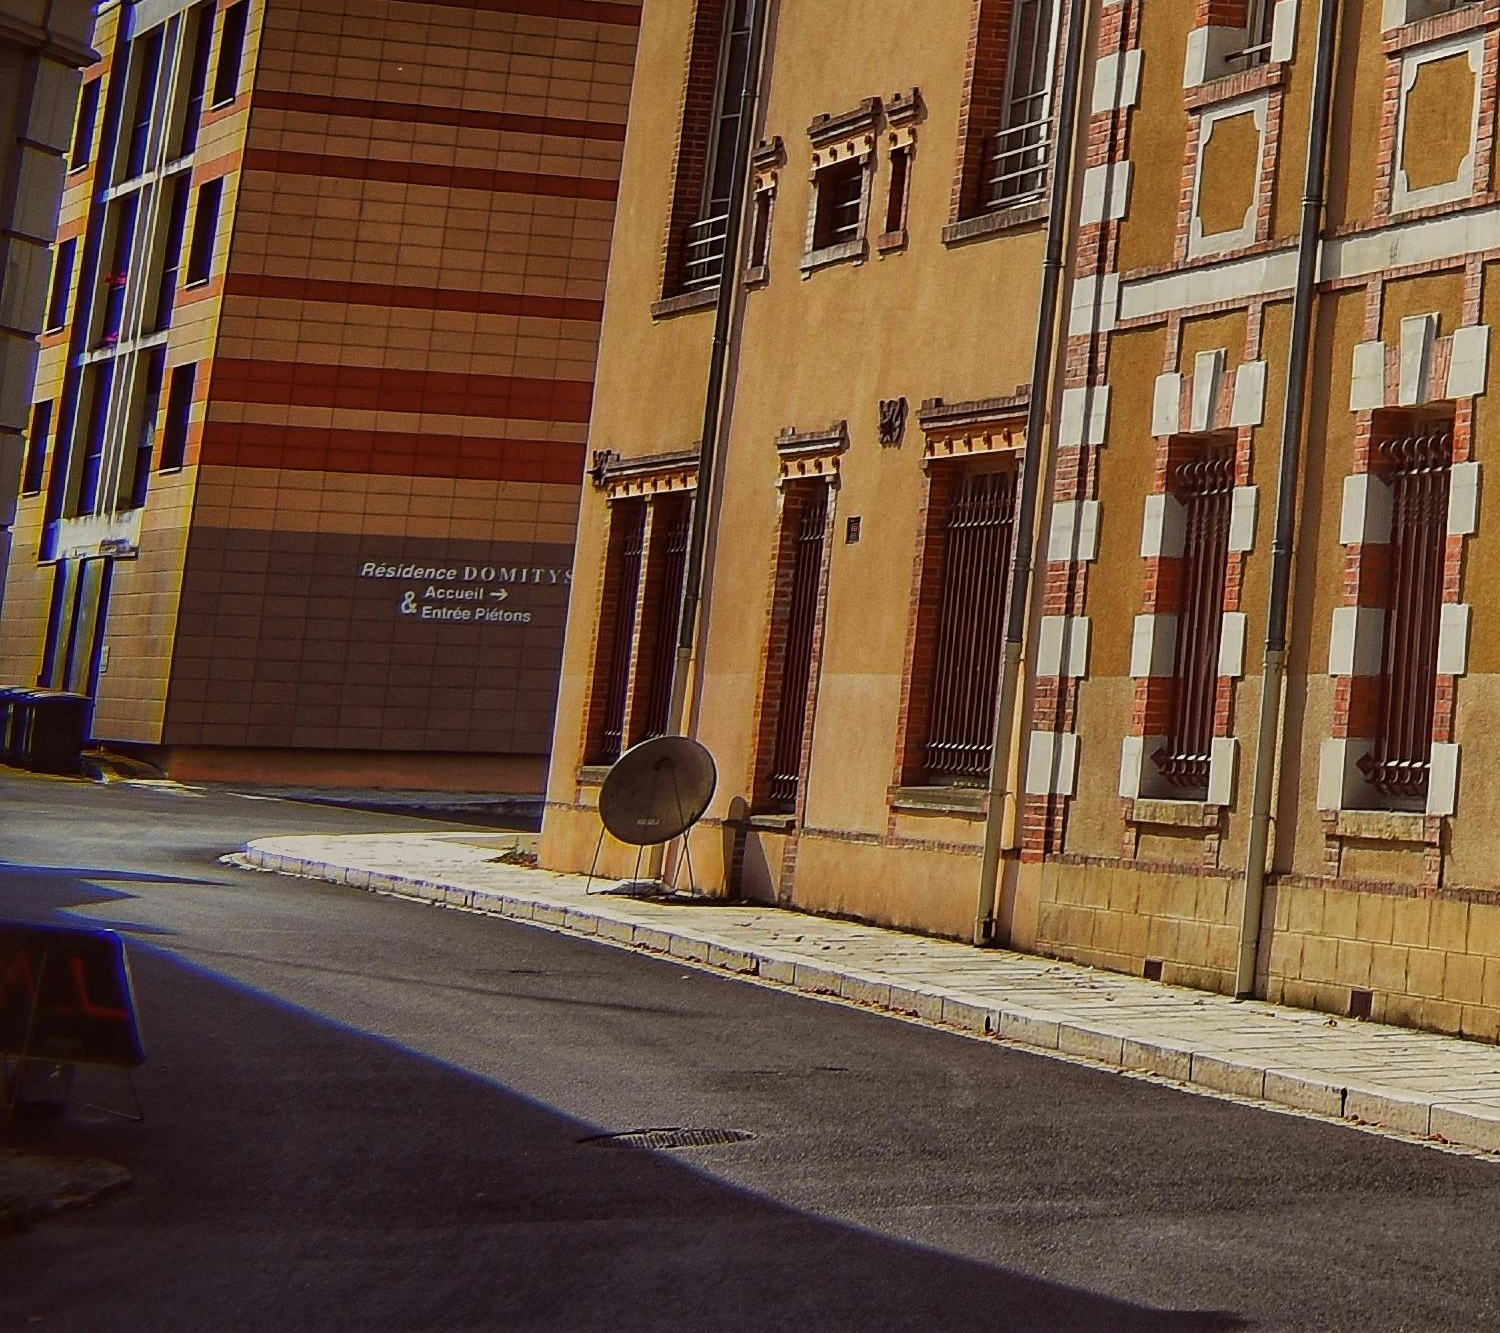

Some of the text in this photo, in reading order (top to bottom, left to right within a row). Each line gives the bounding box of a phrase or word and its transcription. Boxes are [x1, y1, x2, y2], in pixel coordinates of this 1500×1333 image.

[361, 562, 457, 580] Résidence
[425, 585, 484, 600] Accueil
[401, 591, 417, 614] &
[421, 605, 531, 623] Entrée Piétons
